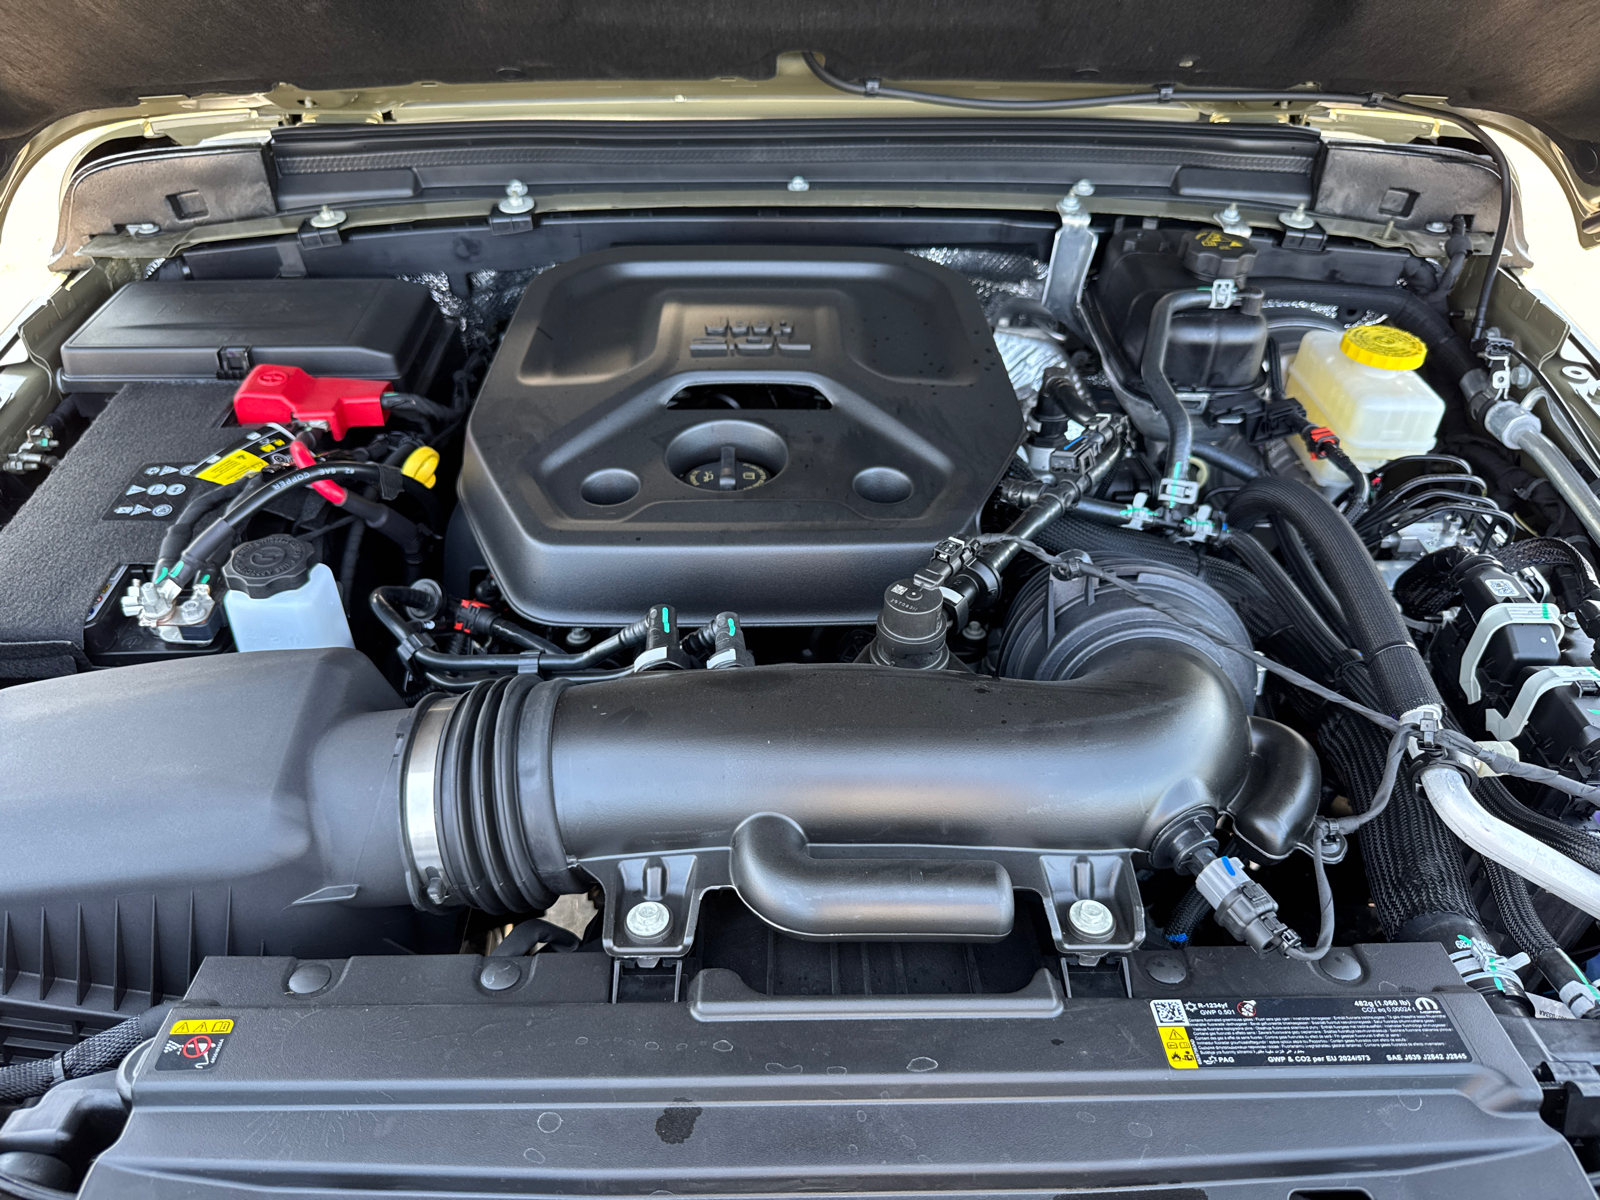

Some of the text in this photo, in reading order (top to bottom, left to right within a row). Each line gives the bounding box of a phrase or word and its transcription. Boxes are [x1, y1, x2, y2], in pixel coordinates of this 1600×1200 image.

[318, 466, 337, 475] SAE
[271, 471, 311, 491] COPPER
[1400, 999, 1411, 1007] lb)
